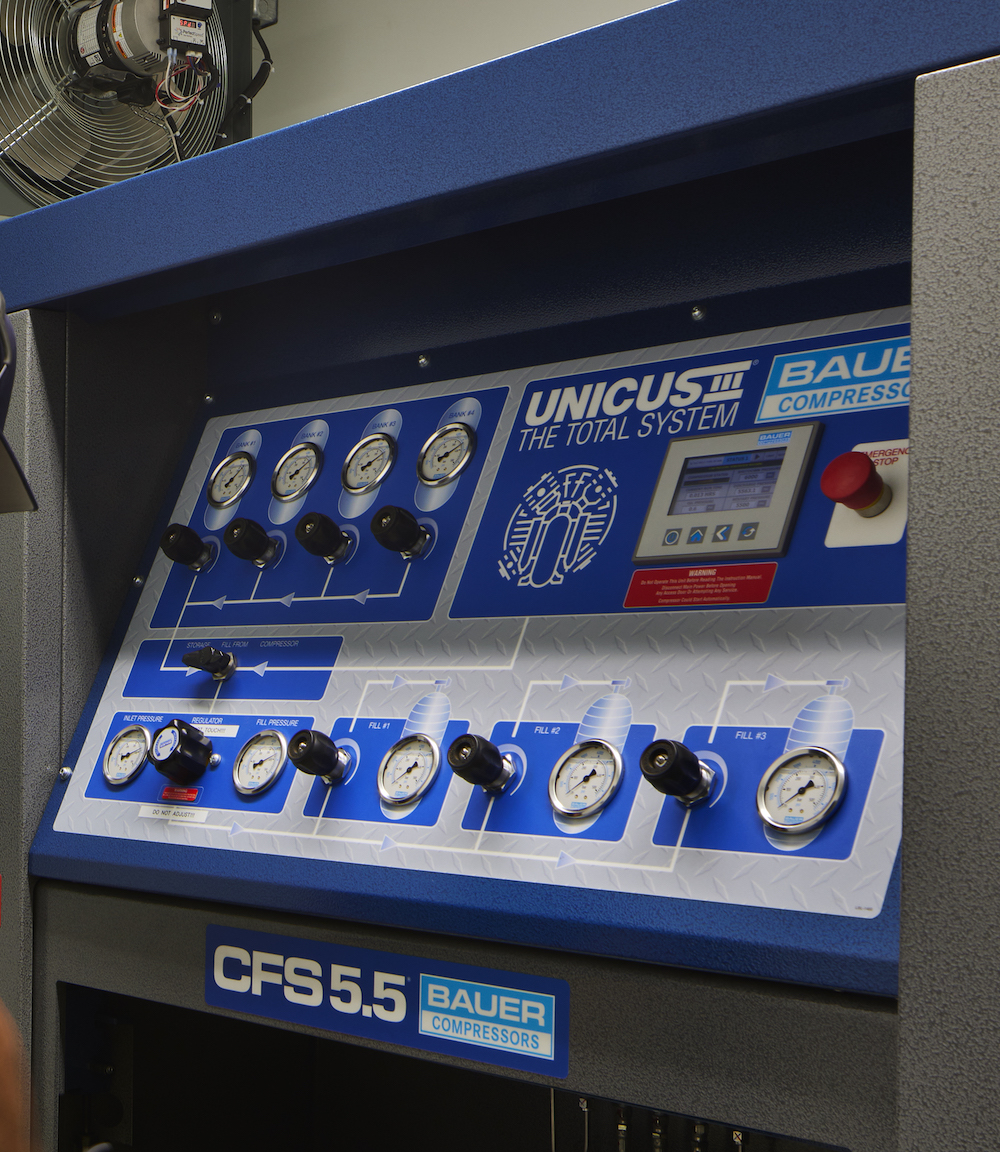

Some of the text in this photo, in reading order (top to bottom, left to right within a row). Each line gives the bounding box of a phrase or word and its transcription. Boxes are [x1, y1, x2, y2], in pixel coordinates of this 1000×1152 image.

[777, 345, 910, 389] BAUE
[778, 382, 910, 414] COMPRESSO
[449, 411, 467, 419] BANK
[372, 421, 389, 430] BANK
[518, 402, 740, 452] THE TOTAL SYSTEM
[301, 431, 316, 439] BANK
[760, 432, 791, 440] BAUER
[864, 447, 909, 458] MERGENC
[873, 457, 899, 467] STOP
[689, 568, 717, 577] WARNING
[260, 640, 299, 648] COMPRESSOR
[137, 715, 164, 723] PRESSURE
[191, 716, 223, 724] REGULATOR
[268, 719, 300, 727] PRESSURE
[368, 721, 381, 729] FILL
[534, 725, 561, 735] FILL #2
[735, 730, 767, 740] FILL #3
[213, 945, 407, 1023] CFS 5.5
[427, 983, 546, 1027] BAUER
[431, 1015, 540, 1051] COMPRESSORS
